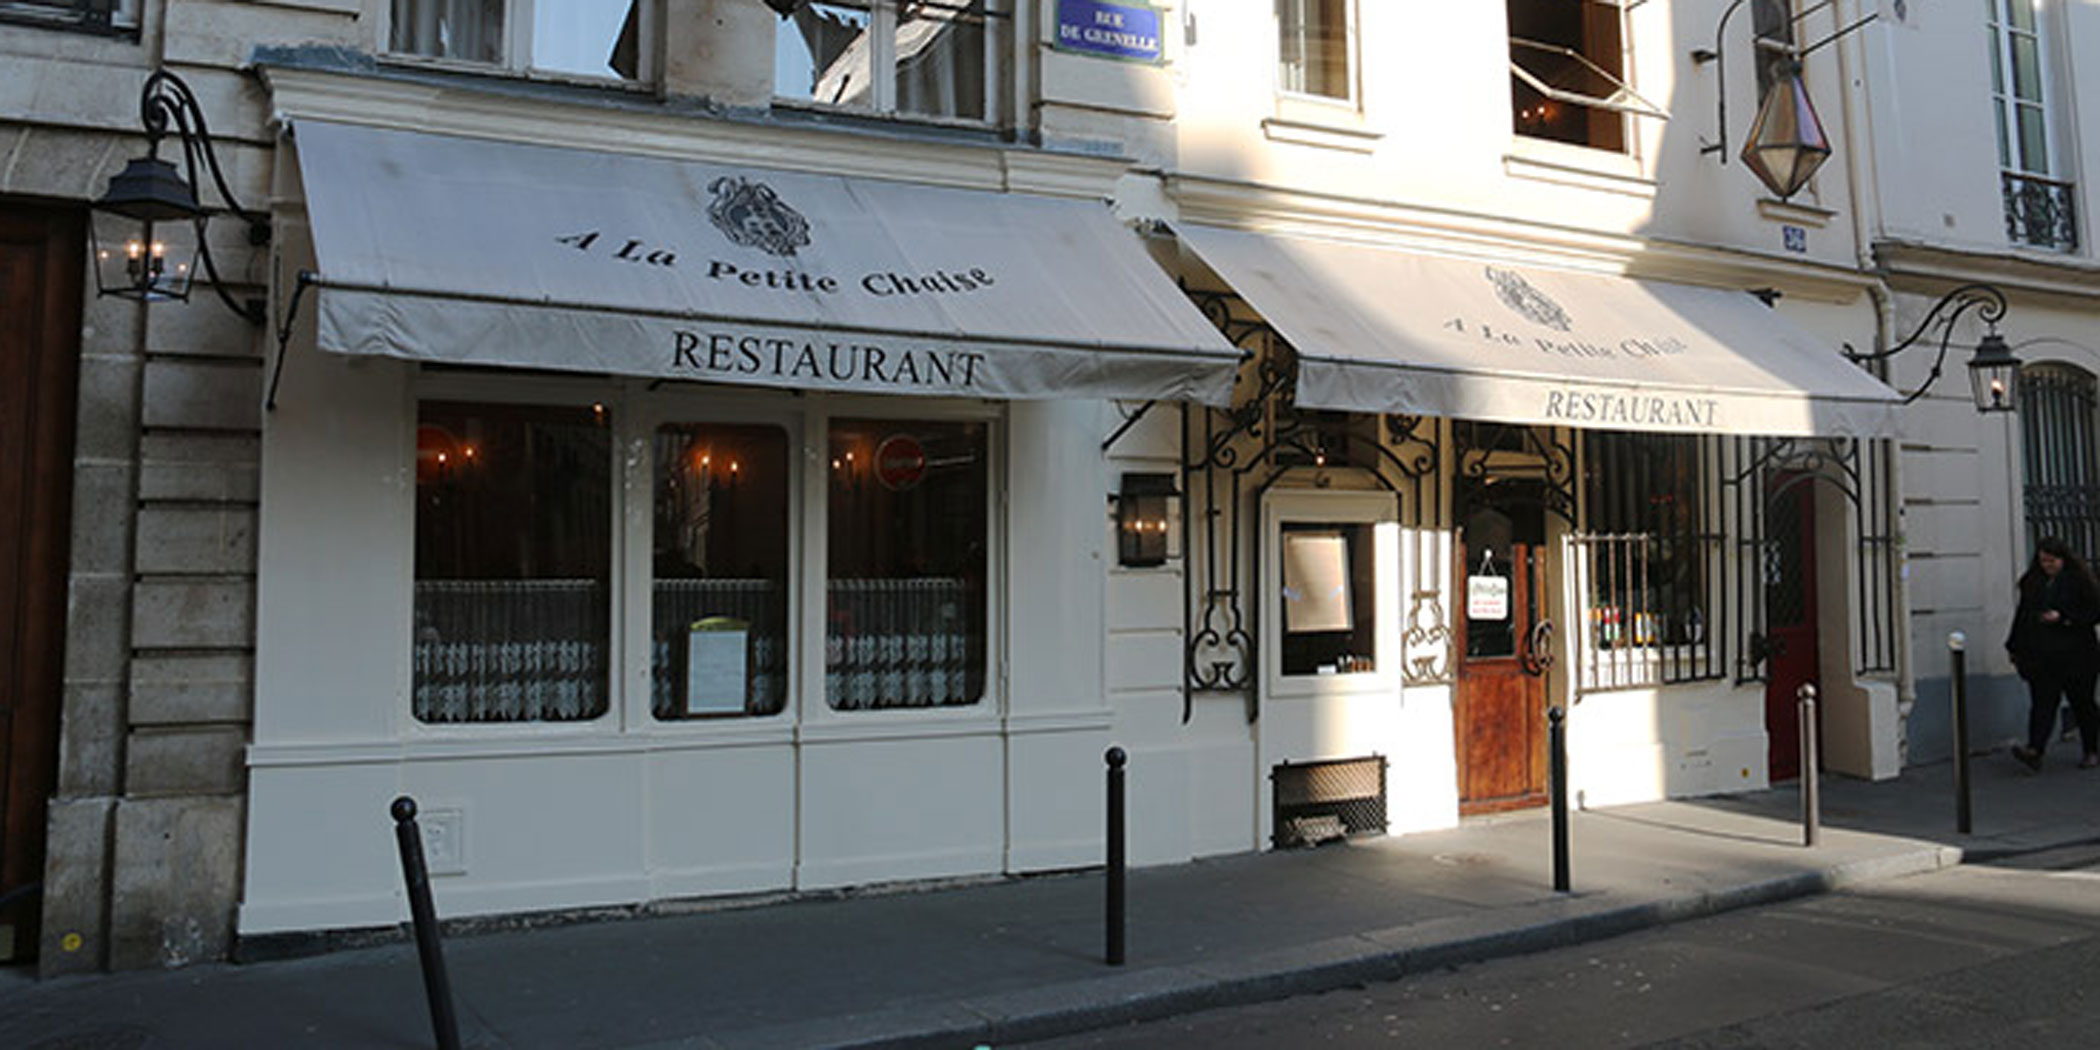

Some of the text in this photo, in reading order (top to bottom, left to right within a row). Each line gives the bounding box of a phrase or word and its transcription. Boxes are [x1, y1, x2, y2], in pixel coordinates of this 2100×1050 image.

[1060, 24, 1157, 50] DE GRENELLE
[1095, 11, 1125, 28] RUE
[555, 231, 994, 297] A La Petite Chaise
[671, 329, 986, 386] RESTAURANT
[1545, 390, 1718, 426] RESTAURANT
